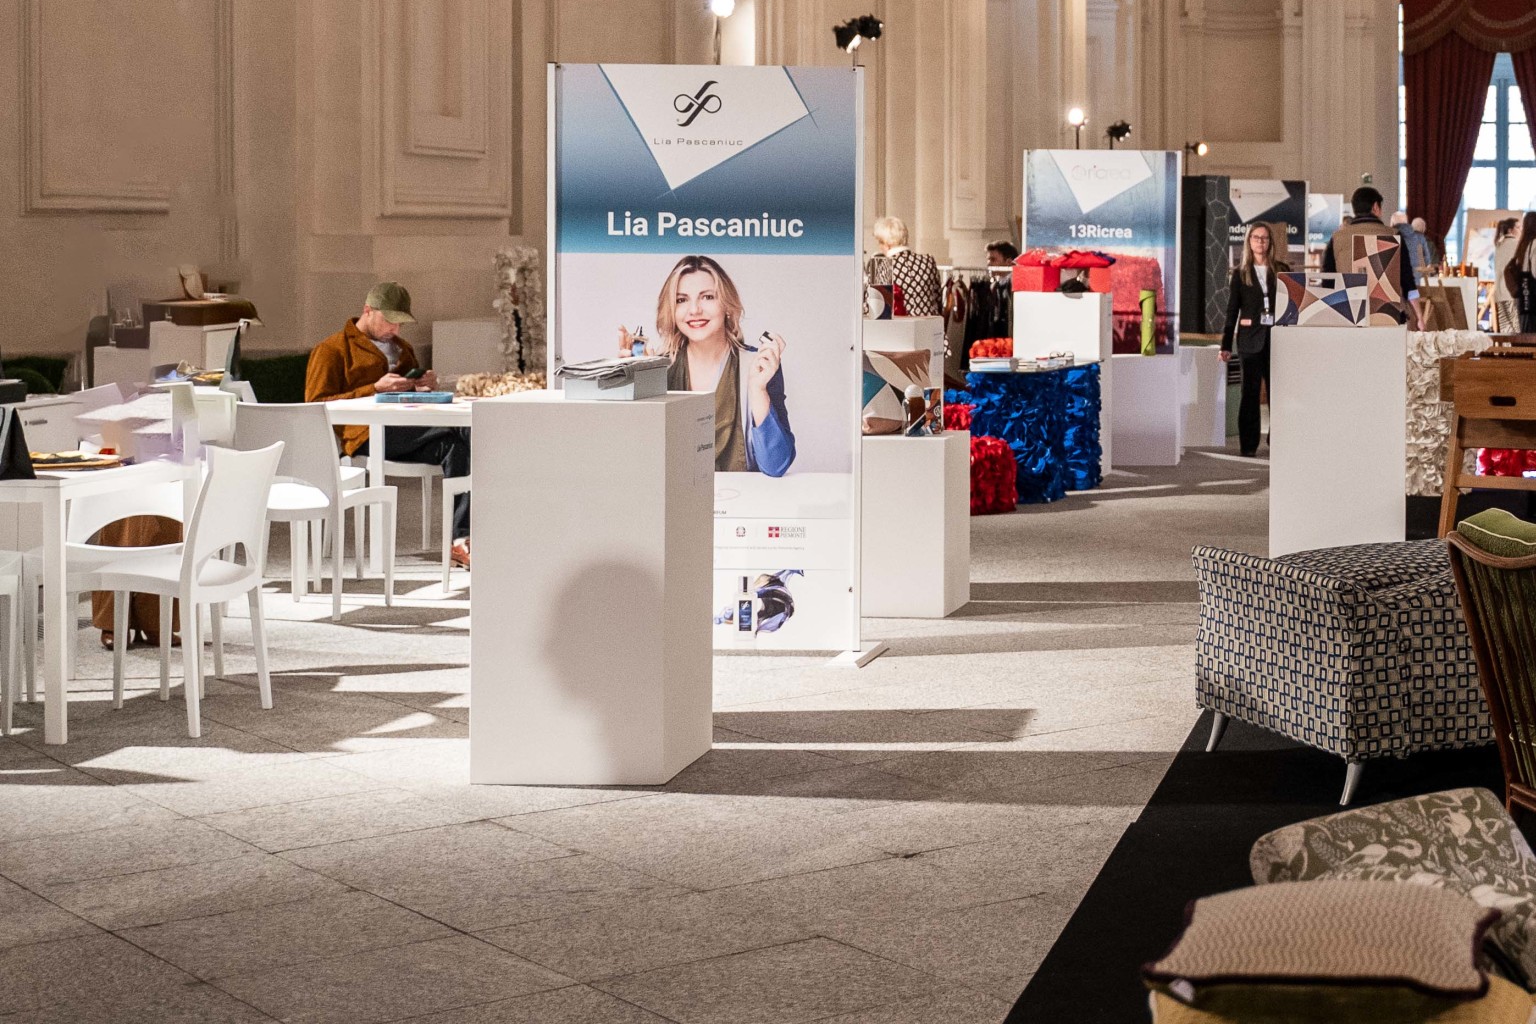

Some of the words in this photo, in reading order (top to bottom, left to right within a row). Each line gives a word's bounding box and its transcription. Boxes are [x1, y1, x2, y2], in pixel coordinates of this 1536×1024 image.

[653, 138, 672, 146] Lia
[677, 138, 744, 146] Pascaniuc
[607, 211, 649, 236] Lia
[657, 211, 804, 238] Pascaniuc
[1068, 224, 1133, 239] 13Ricrea
